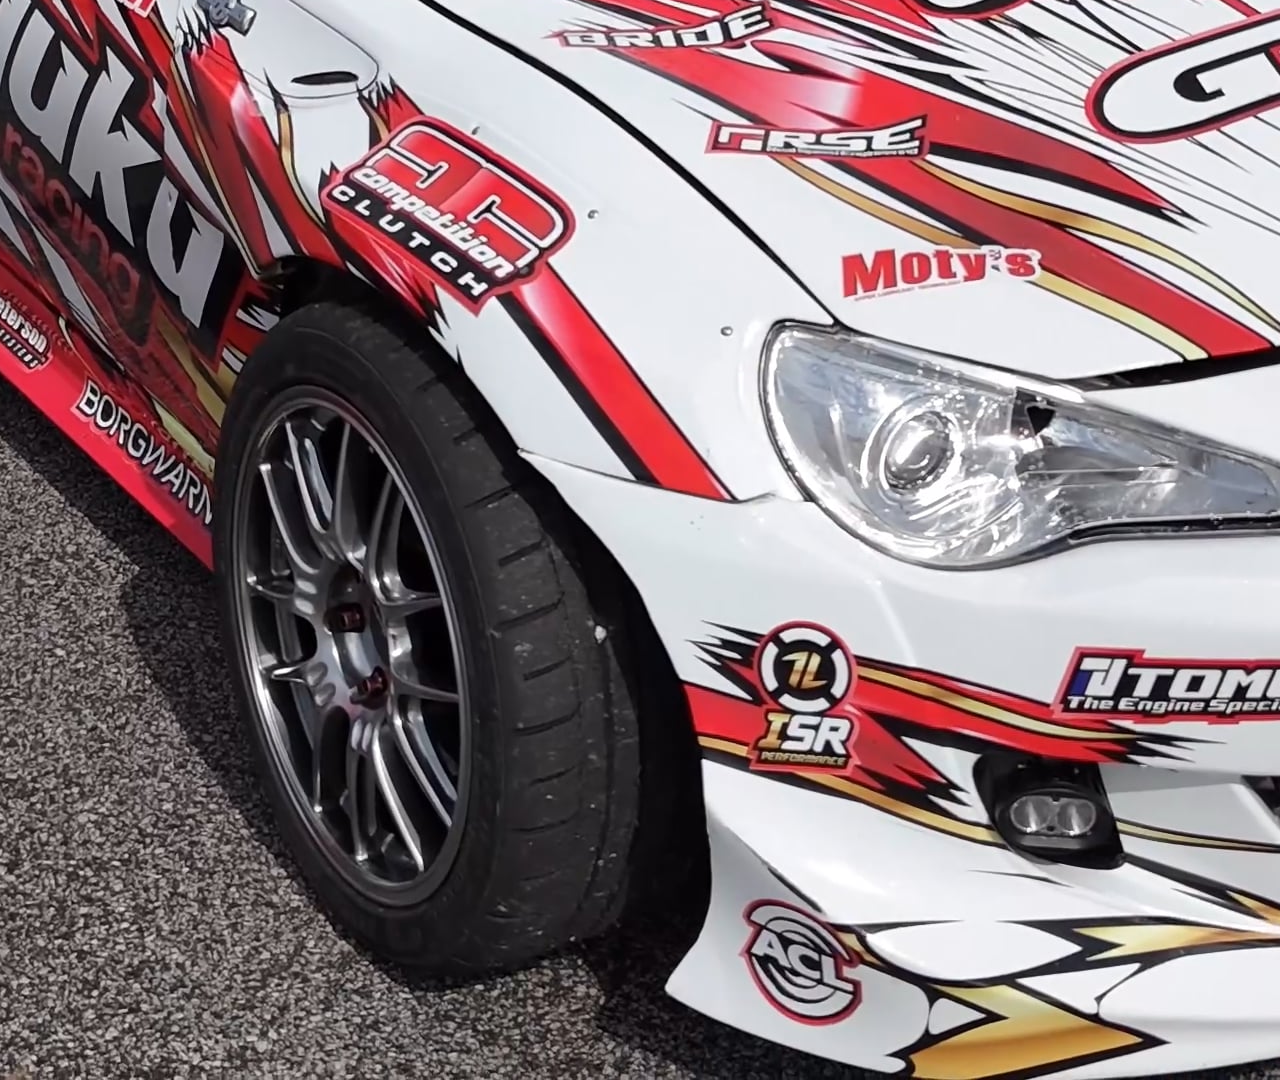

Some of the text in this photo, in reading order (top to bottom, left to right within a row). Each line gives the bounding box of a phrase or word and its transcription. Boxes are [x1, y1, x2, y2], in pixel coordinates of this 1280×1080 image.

[564, 4, 771, 48] BRIDE
[1, 124, 141, 311] racing
[331, 185, 489, 297] CLUTCH
[352, 166, 516, 280] competition
[841, 248, 1036, 298] Moty's
[77, 379, 213, 525] BORGWARN
[757, 711, 852, 756] ISR
[1067, 695, 1114, 710] The
[1117, 697, 1205, 714] Engine
[760, 751, 847, 766] PERFORMANCE
[749, 927, 853, 996] ACL
